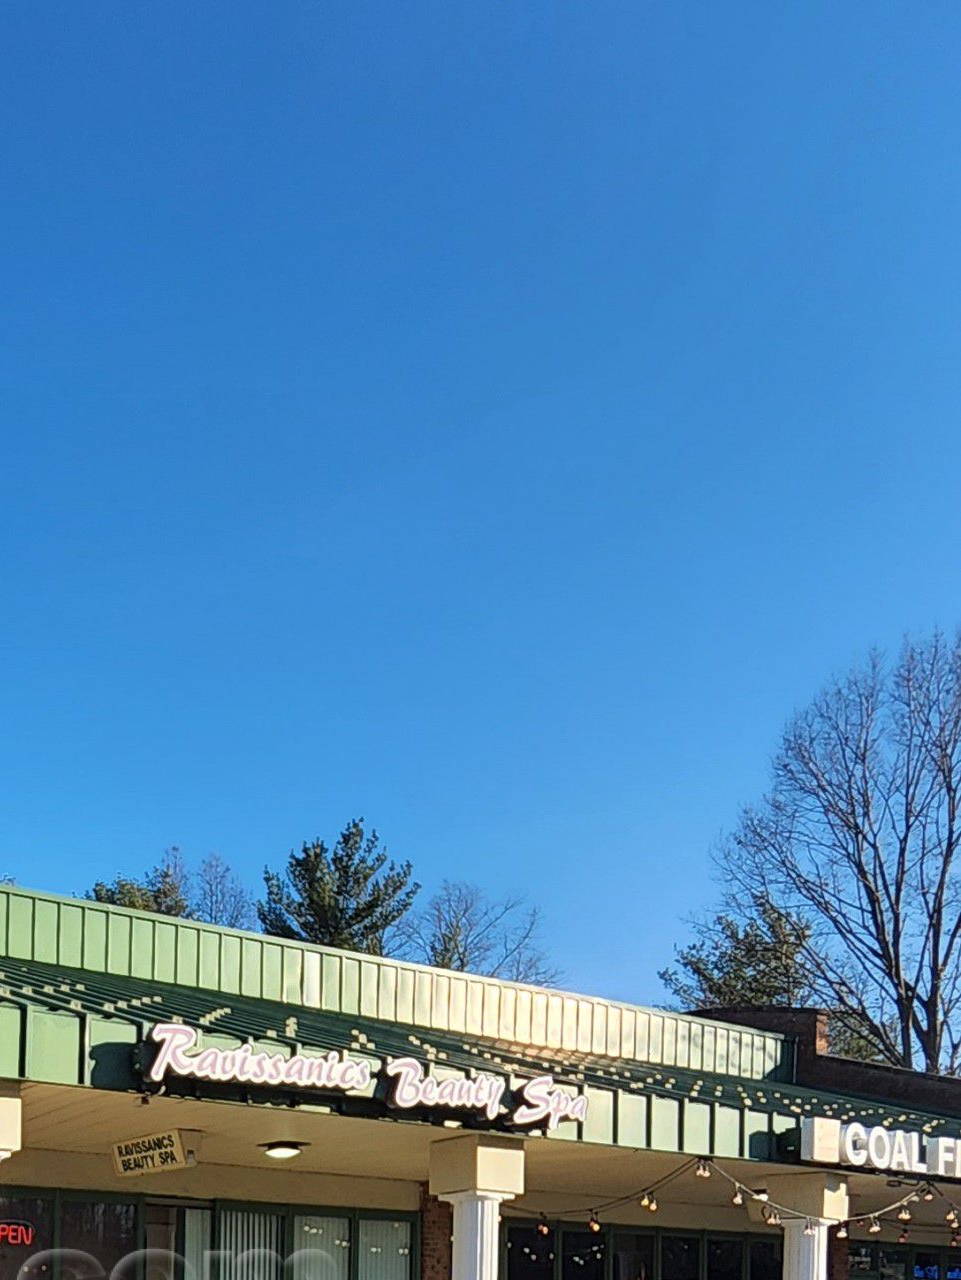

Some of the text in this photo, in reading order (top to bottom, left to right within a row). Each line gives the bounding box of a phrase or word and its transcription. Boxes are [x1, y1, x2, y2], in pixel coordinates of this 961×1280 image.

[150, 1023, 588, 1130] Ravissanics Beauty Spa
[117, 1134, 175, 1158] RAVISSANICS
[121, 1150, 178, 1172] BEAUTY SPA
[844, 1121, 928, 1174] COAL
